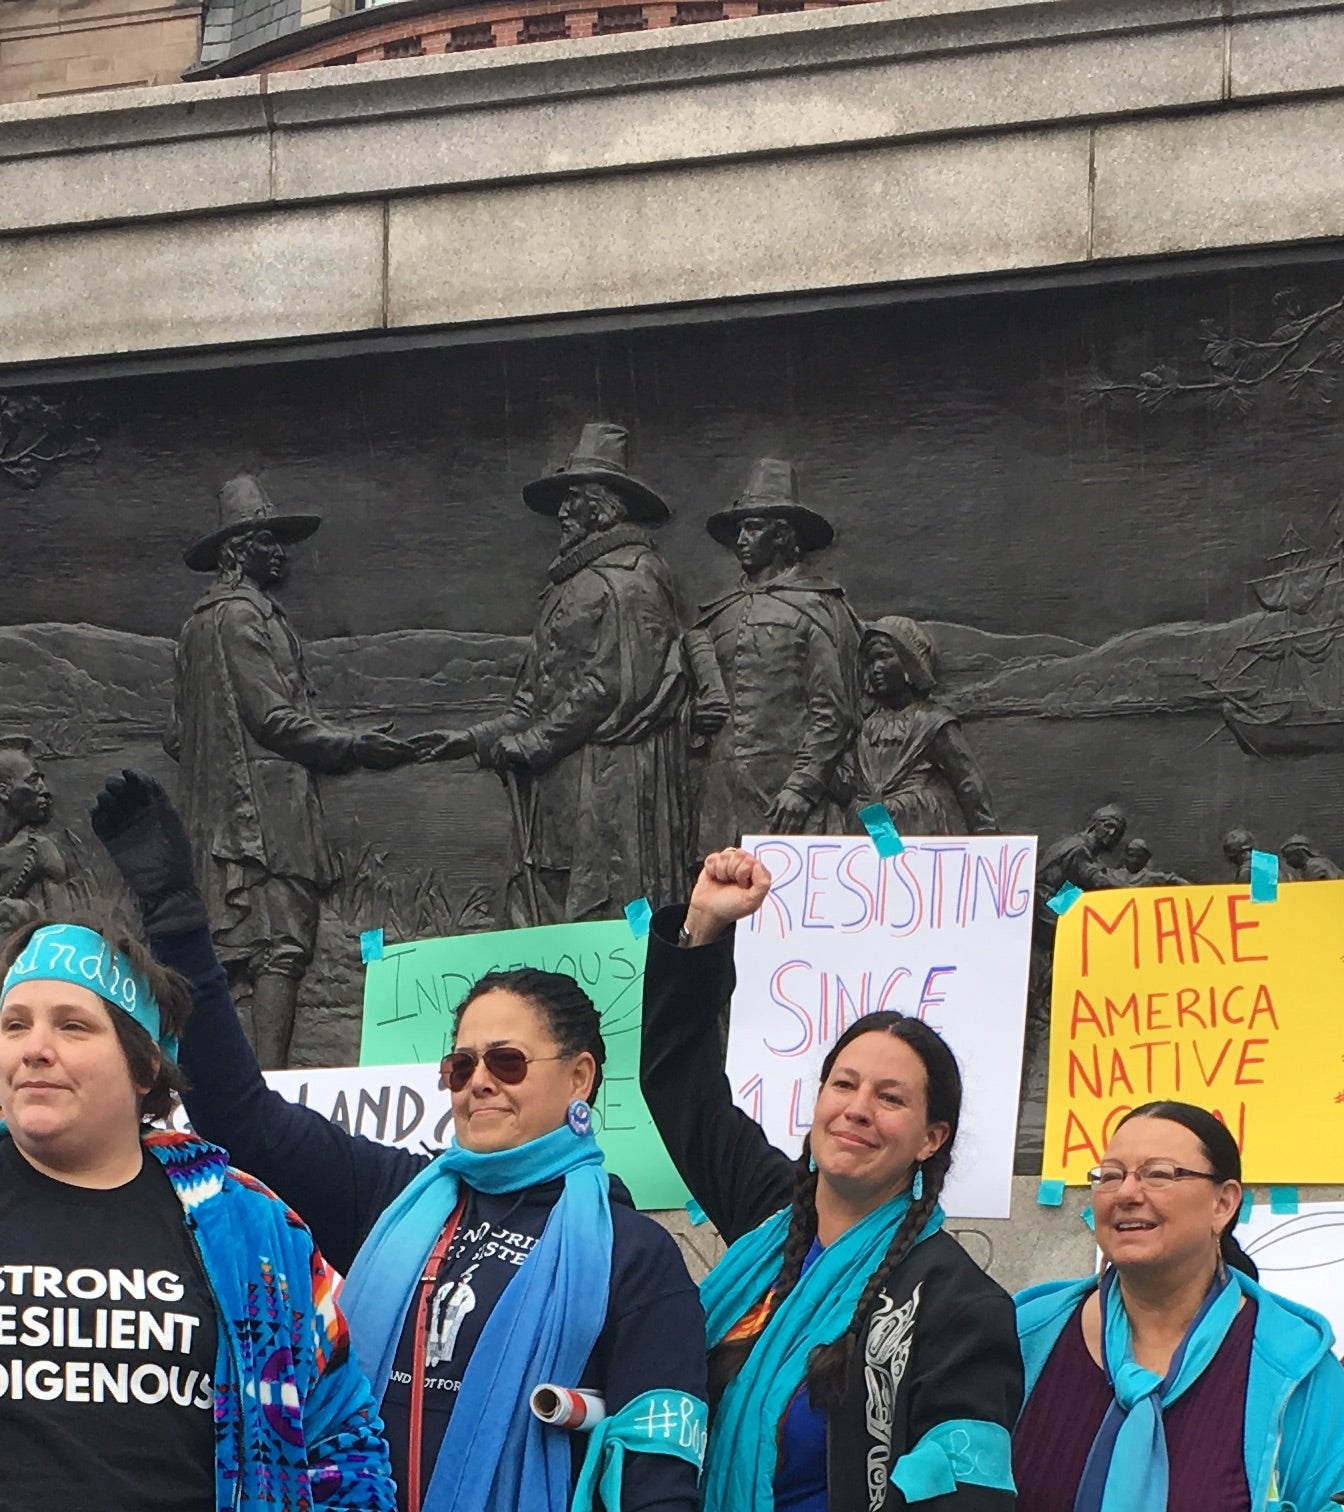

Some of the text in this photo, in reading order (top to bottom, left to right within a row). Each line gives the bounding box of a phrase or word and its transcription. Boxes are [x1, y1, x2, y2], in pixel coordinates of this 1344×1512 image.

[750, 841, 1031, 939] RESISTING
[1081, 894, 1269, 977] MAKE
[1070, 984, 1280, 1040] AMERICA
[1068, 1038, 1270, 1099] NATIVE
